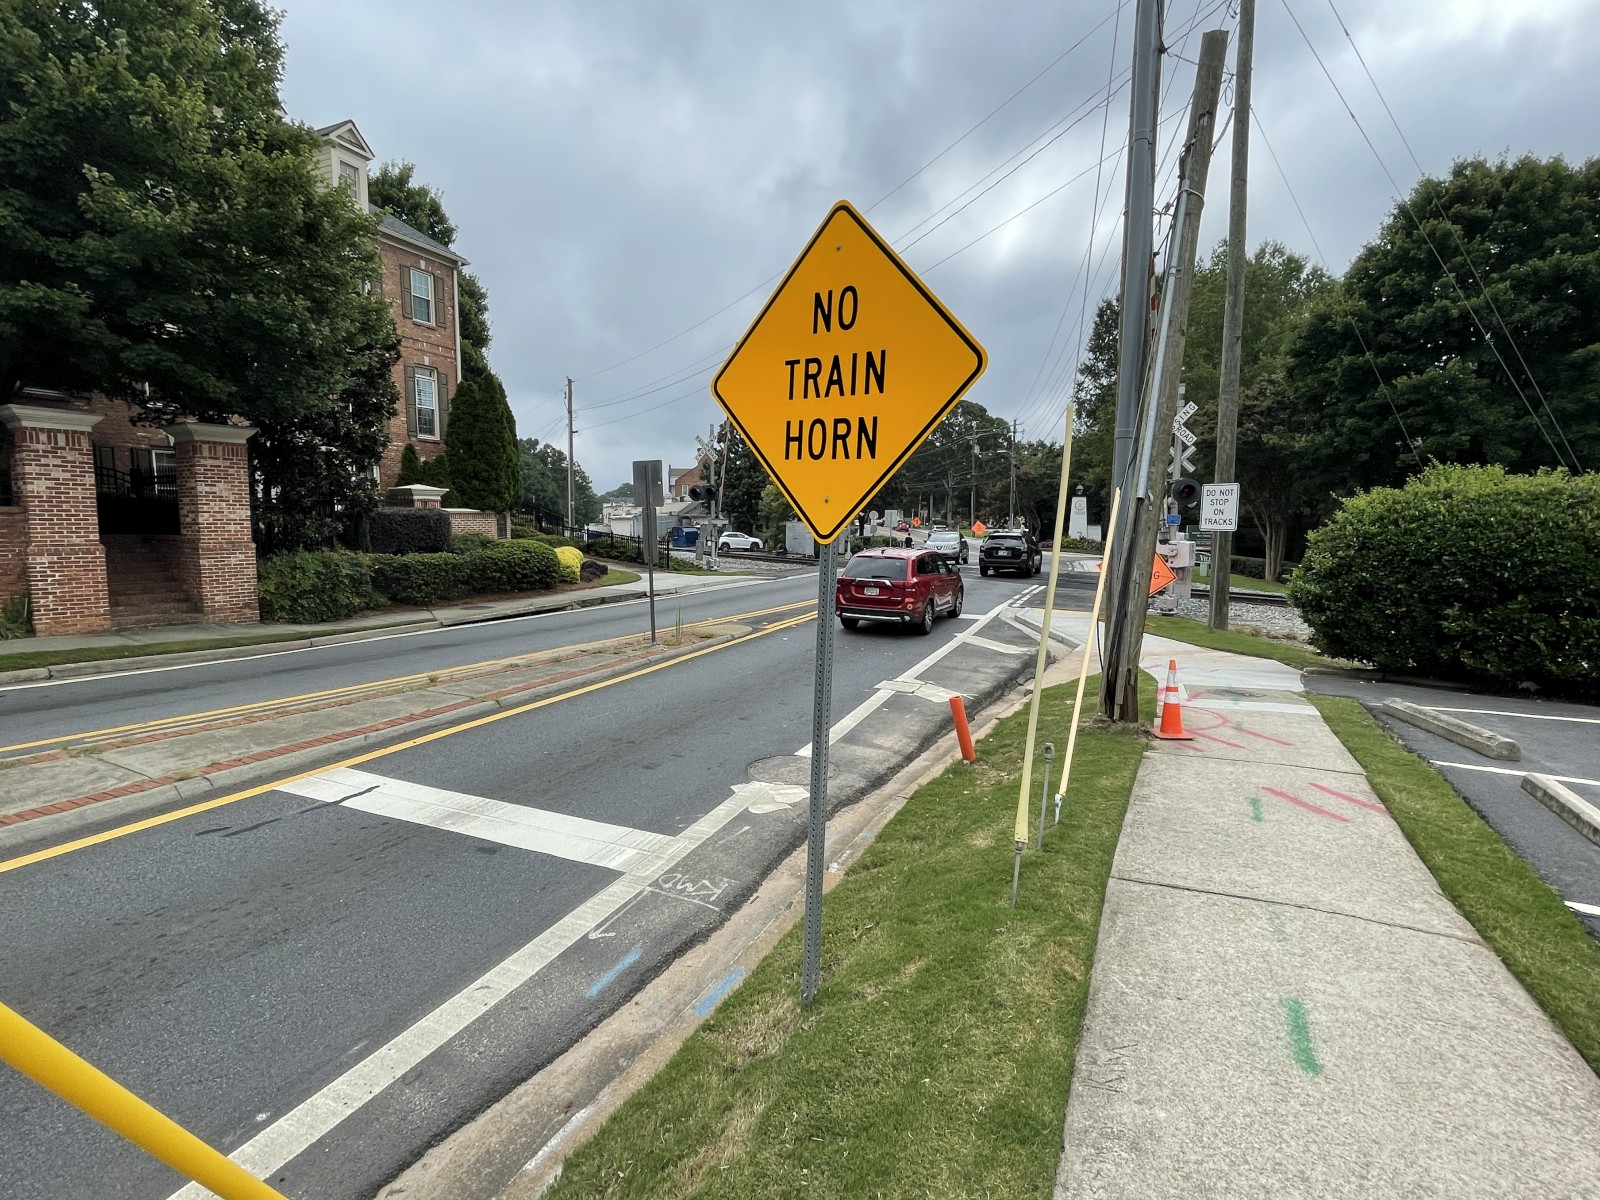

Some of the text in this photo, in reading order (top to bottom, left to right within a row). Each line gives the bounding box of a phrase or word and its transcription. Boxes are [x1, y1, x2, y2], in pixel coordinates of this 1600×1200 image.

[813, 285, 858, 334] NO
[784, 349, 887, 400] TRAIN
[784, 416, 878, 461] HORN
[1220, 489, 1234, 497] NOT
[1204, 518, 1233, 526] TRACKS
